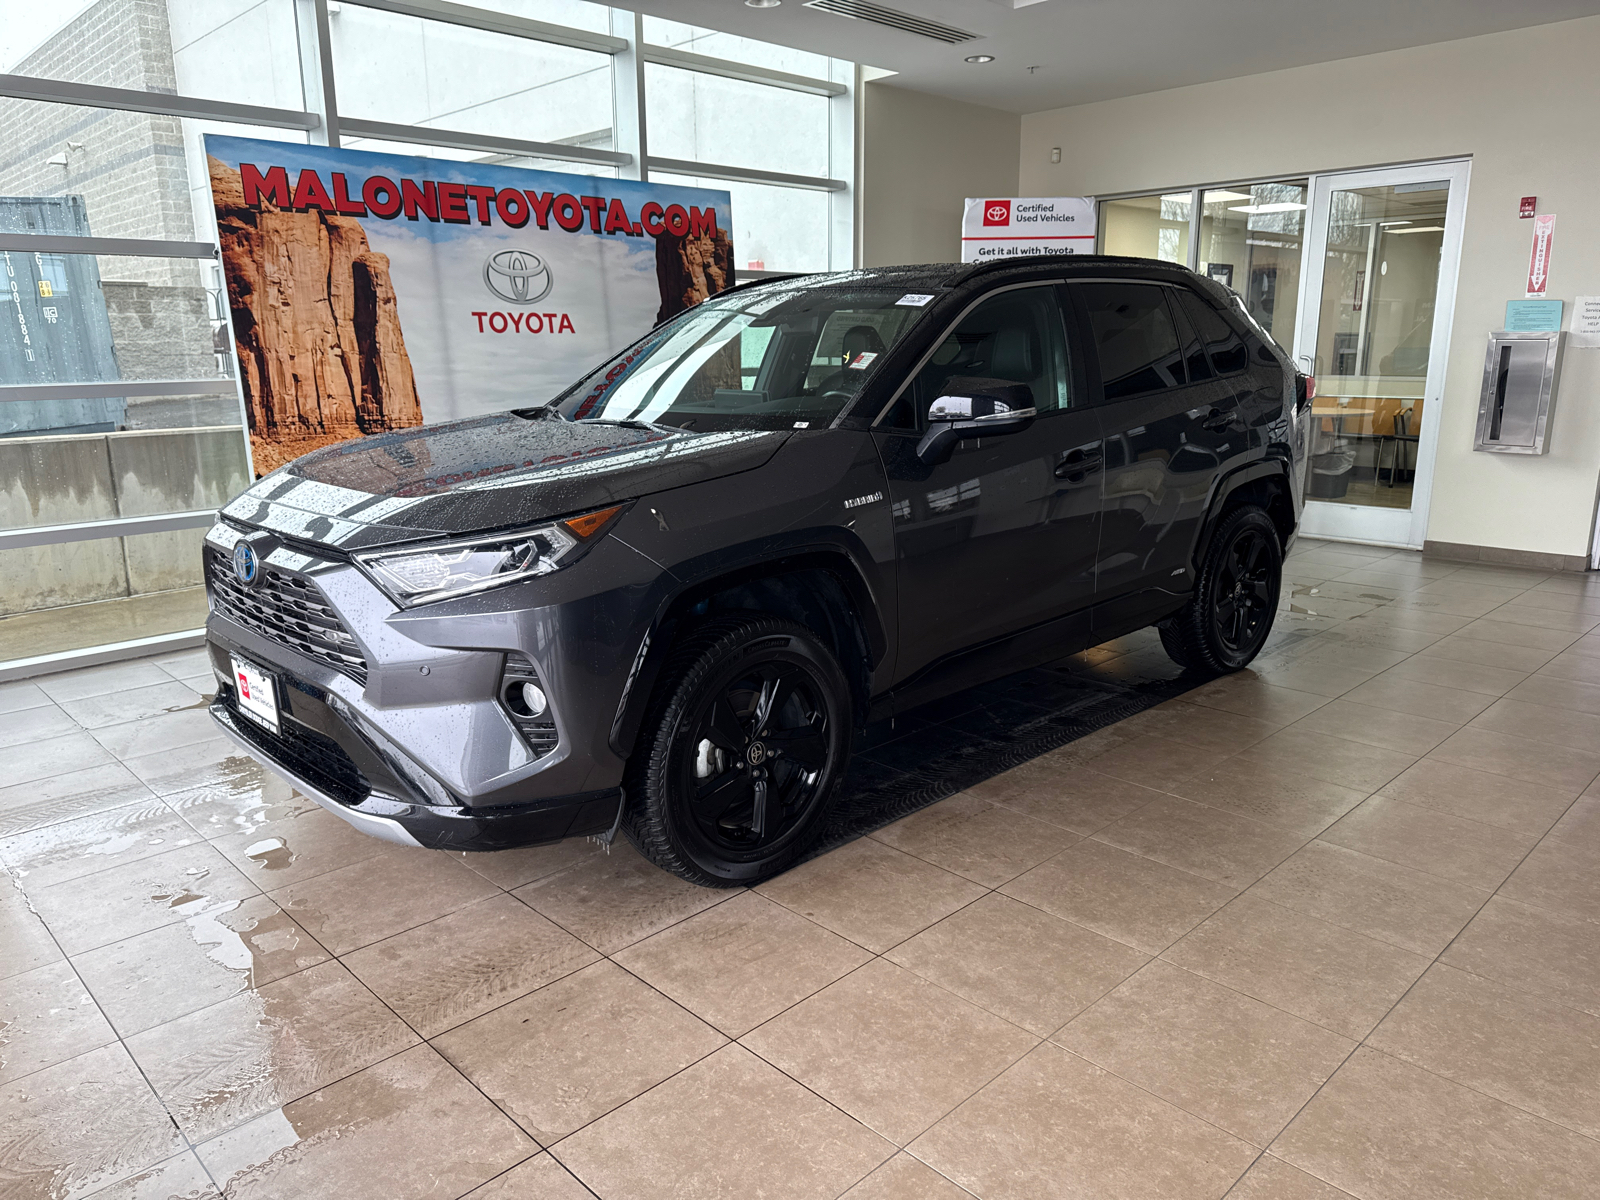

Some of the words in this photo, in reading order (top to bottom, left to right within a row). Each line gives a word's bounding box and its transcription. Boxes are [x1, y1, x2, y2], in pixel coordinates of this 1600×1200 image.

[240, 162, 719, 242] MALONETOYOTA.COM
[1016, 203, 1054, 212] Certified
[1016, 213, 1038, 222] Used
[1040, 213, 1075, 222] Vehicles
[978, 247, 996, 256] Get
[997, 246, 1005, 256] it
[1006, 246, 1019, 255] all
[1020, 246, 1041, 255] with
[1043, 246, 1074, 255] Toyota
[471, 311, 576, 334] TOYOTA
